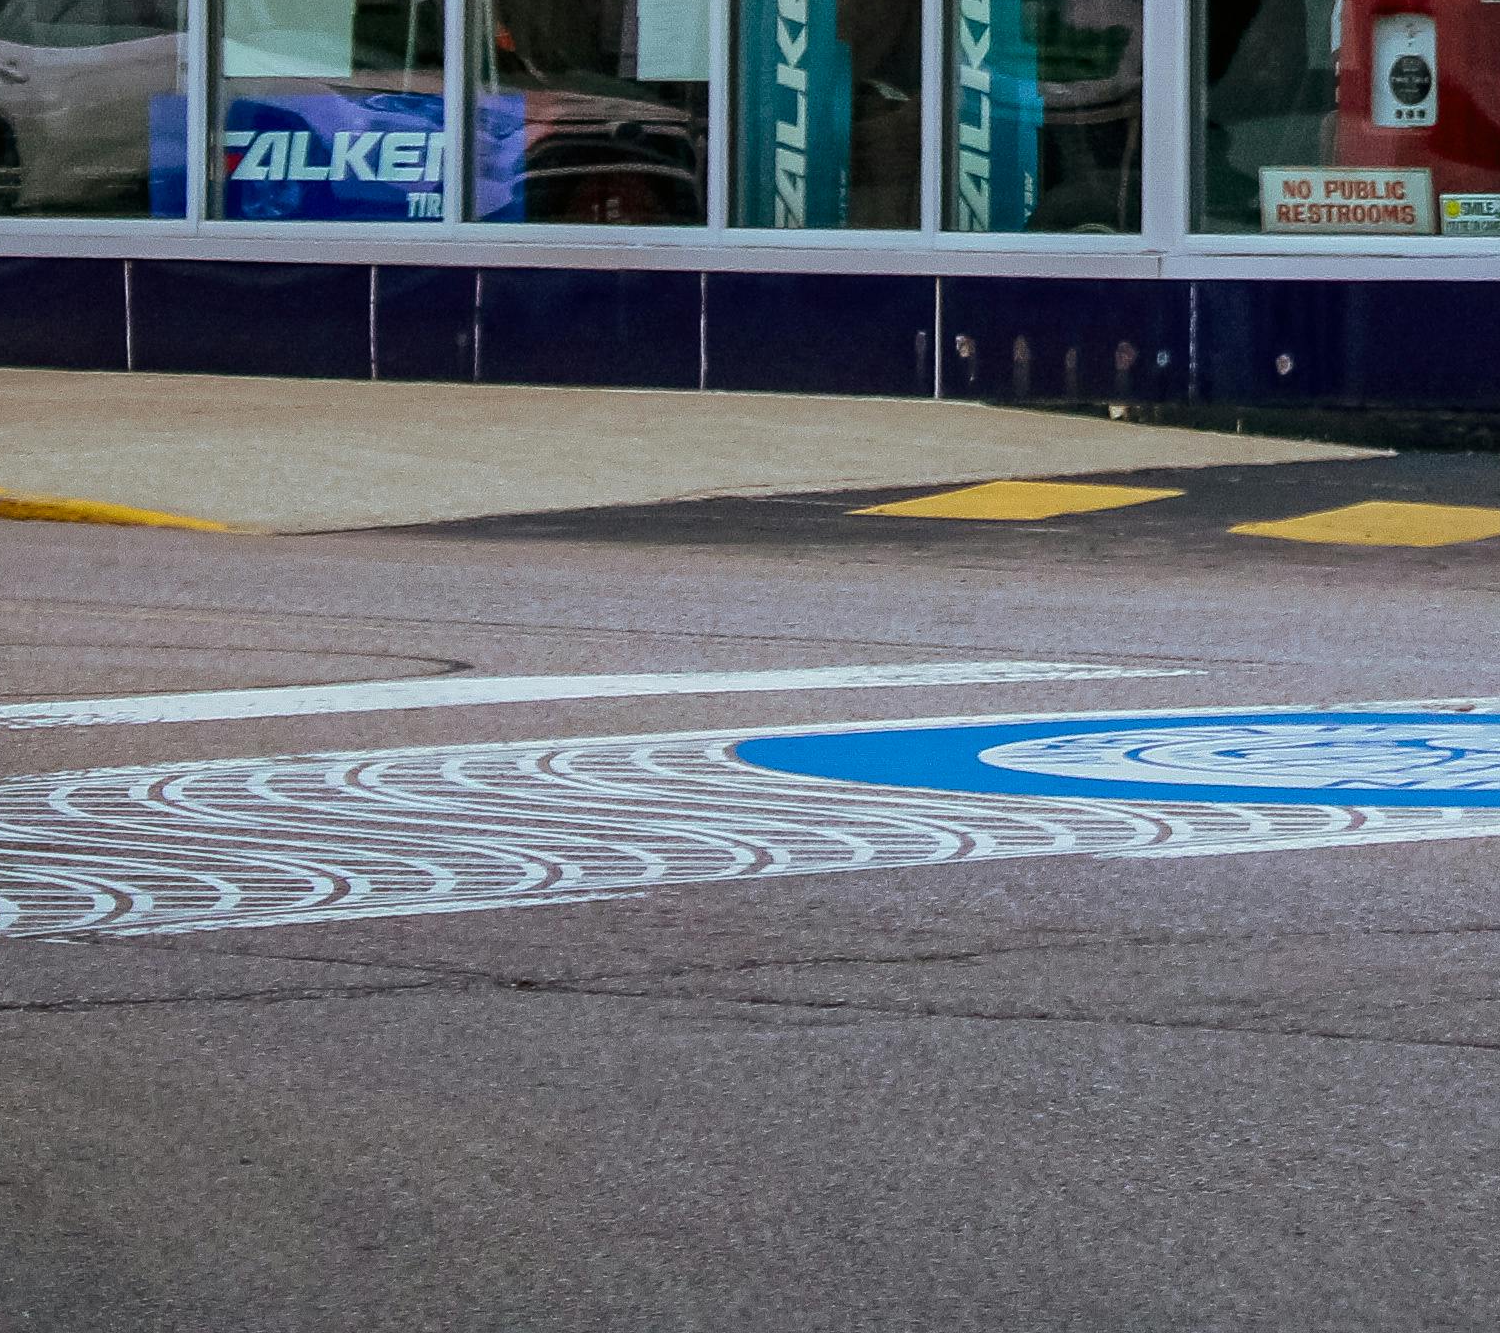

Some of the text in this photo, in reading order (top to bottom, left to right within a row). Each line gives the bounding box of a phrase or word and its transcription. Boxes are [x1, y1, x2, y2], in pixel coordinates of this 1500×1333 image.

[1281, 180, 1406, 201] NO PUBLIC
[406, 192, 444, 217] TIR
[1277, 204, 1416, 226] RESTROOMS
